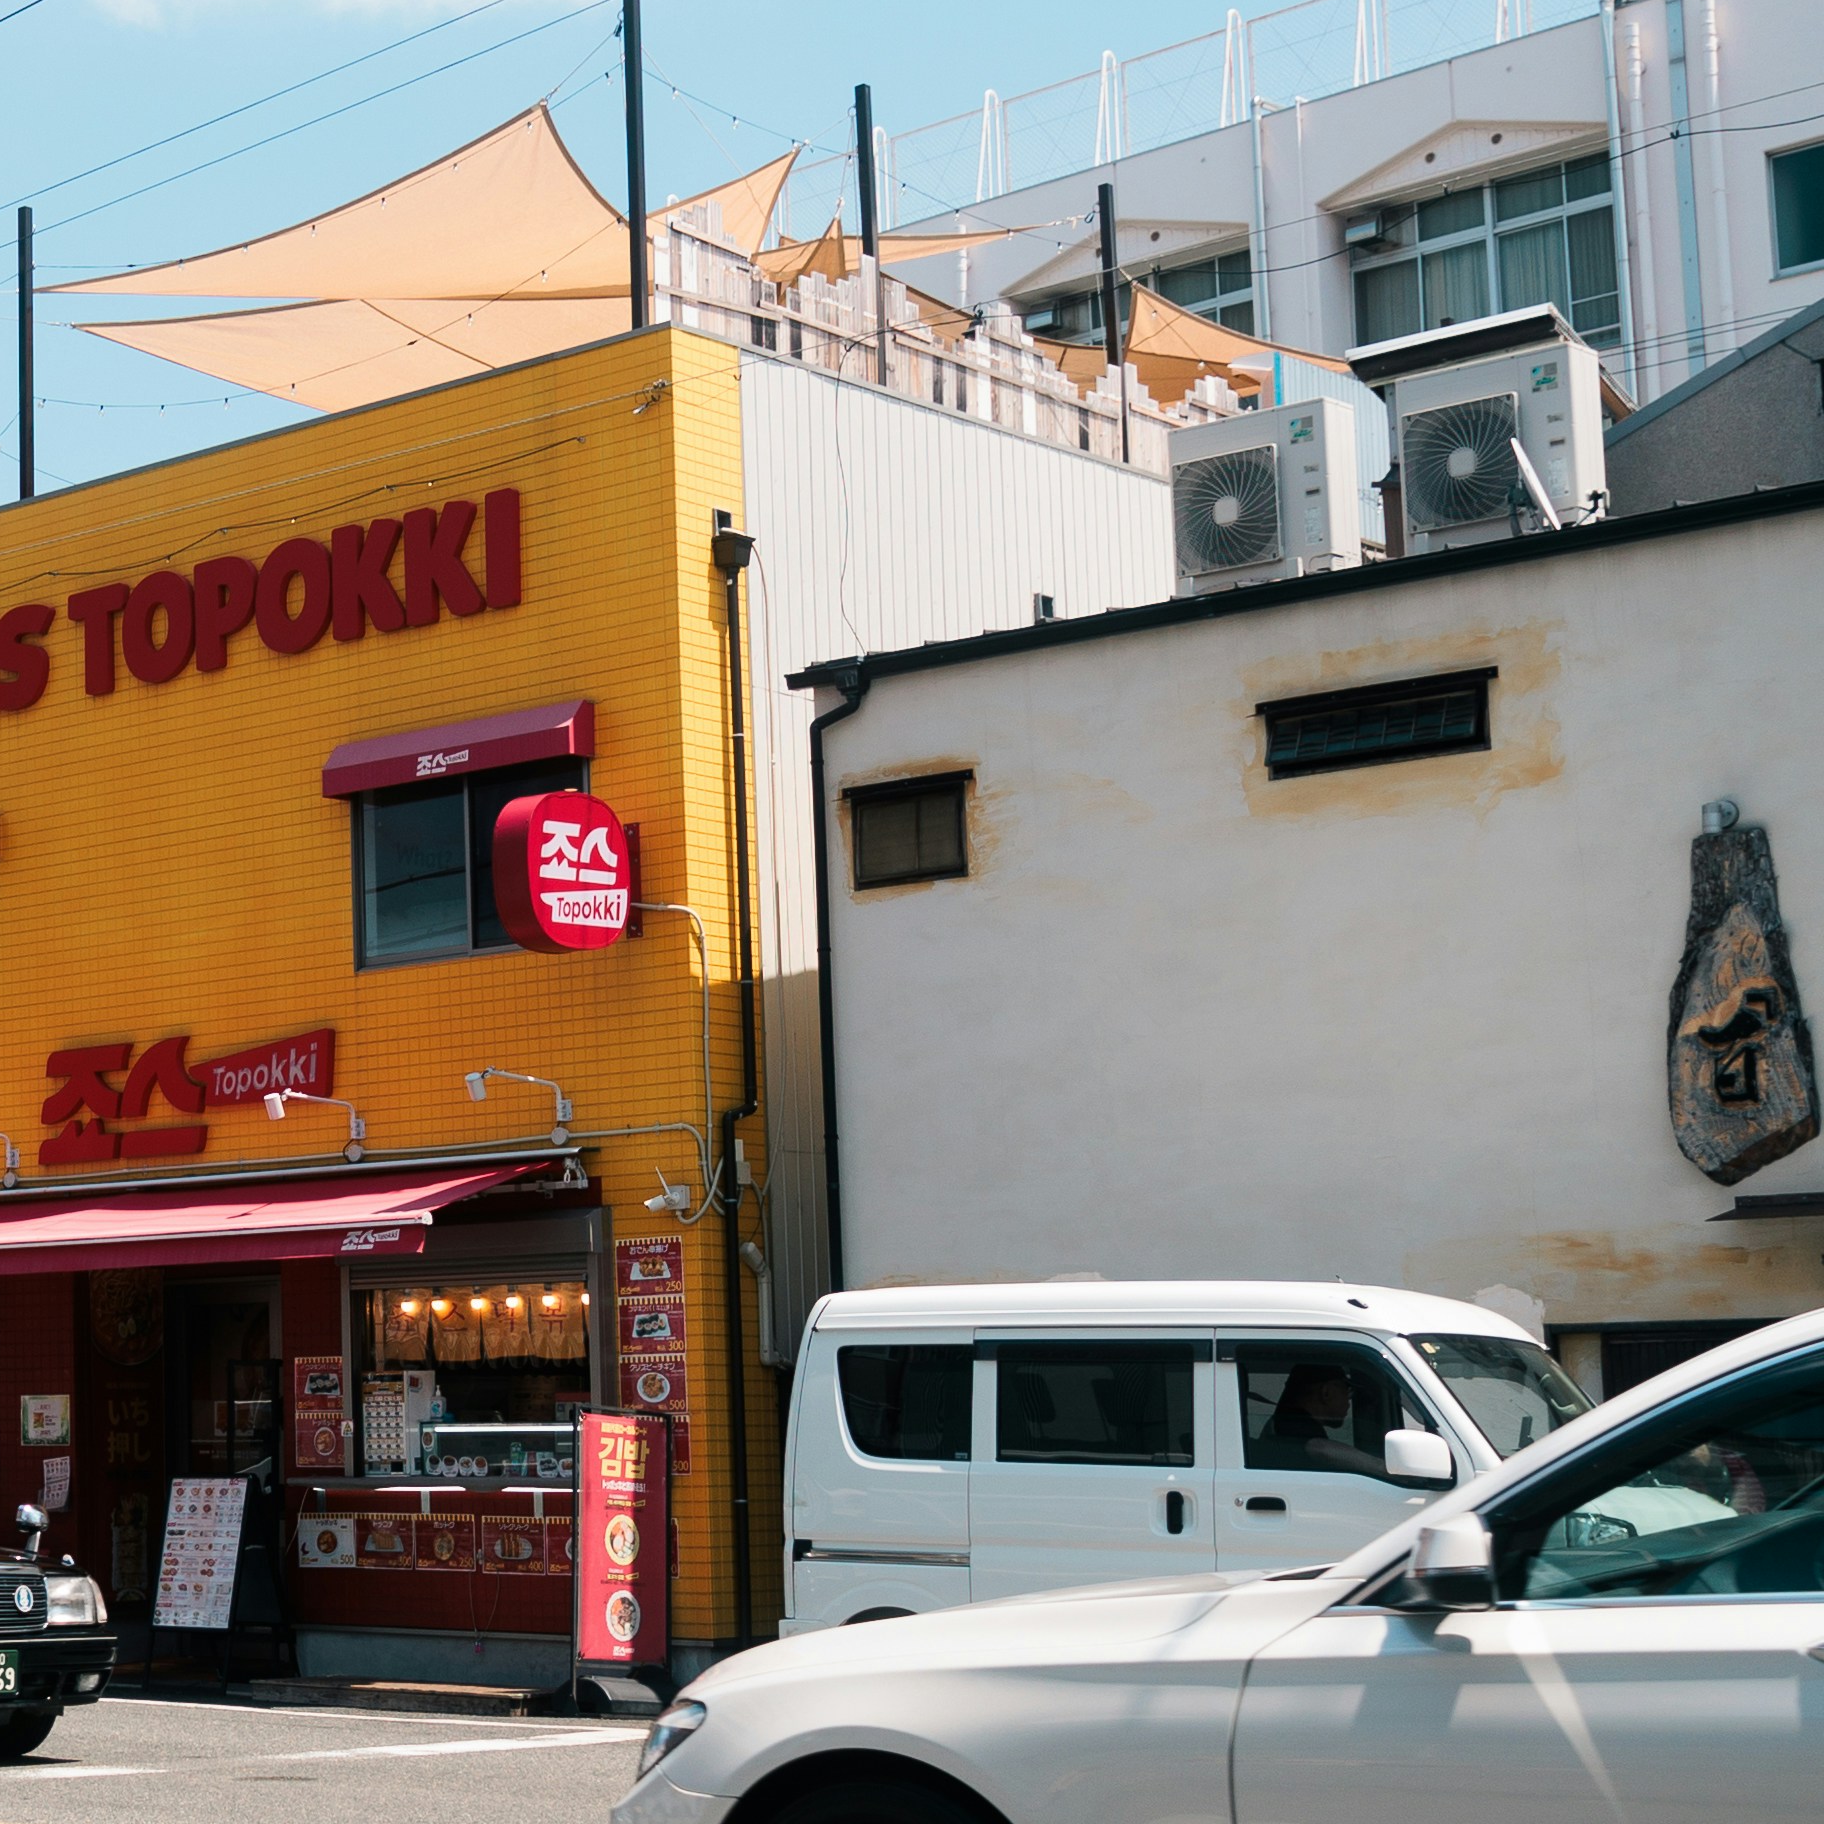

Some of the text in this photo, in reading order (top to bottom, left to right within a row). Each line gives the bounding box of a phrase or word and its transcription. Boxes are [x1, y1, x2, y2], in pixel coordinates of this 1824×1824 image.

[67, 487, 522, 698] TOPOKKI
[540, 819, 618, 886] 죠스
[556, 893, 621, 923] Topokki
[213, 1042, 319, 1100] Topokki
[38, 1035, 210, 1166] 죠스
[665, 1281, 682, 1292] 250
[668, 1340, 684, 1352] 300
[107, 1397, 150, 1427] いち
[669, 1399, 685, 1410] 500
[107, 1431, 151, 1464] 押し
[598, 1436, 651, 1480] 김밥
[672, 1460, 689, 1472] 500
[340, 1554, 354, 1565] 500
[459, 1557, 474, 1568] 250
[528, 1560, 544, 1572] 400
